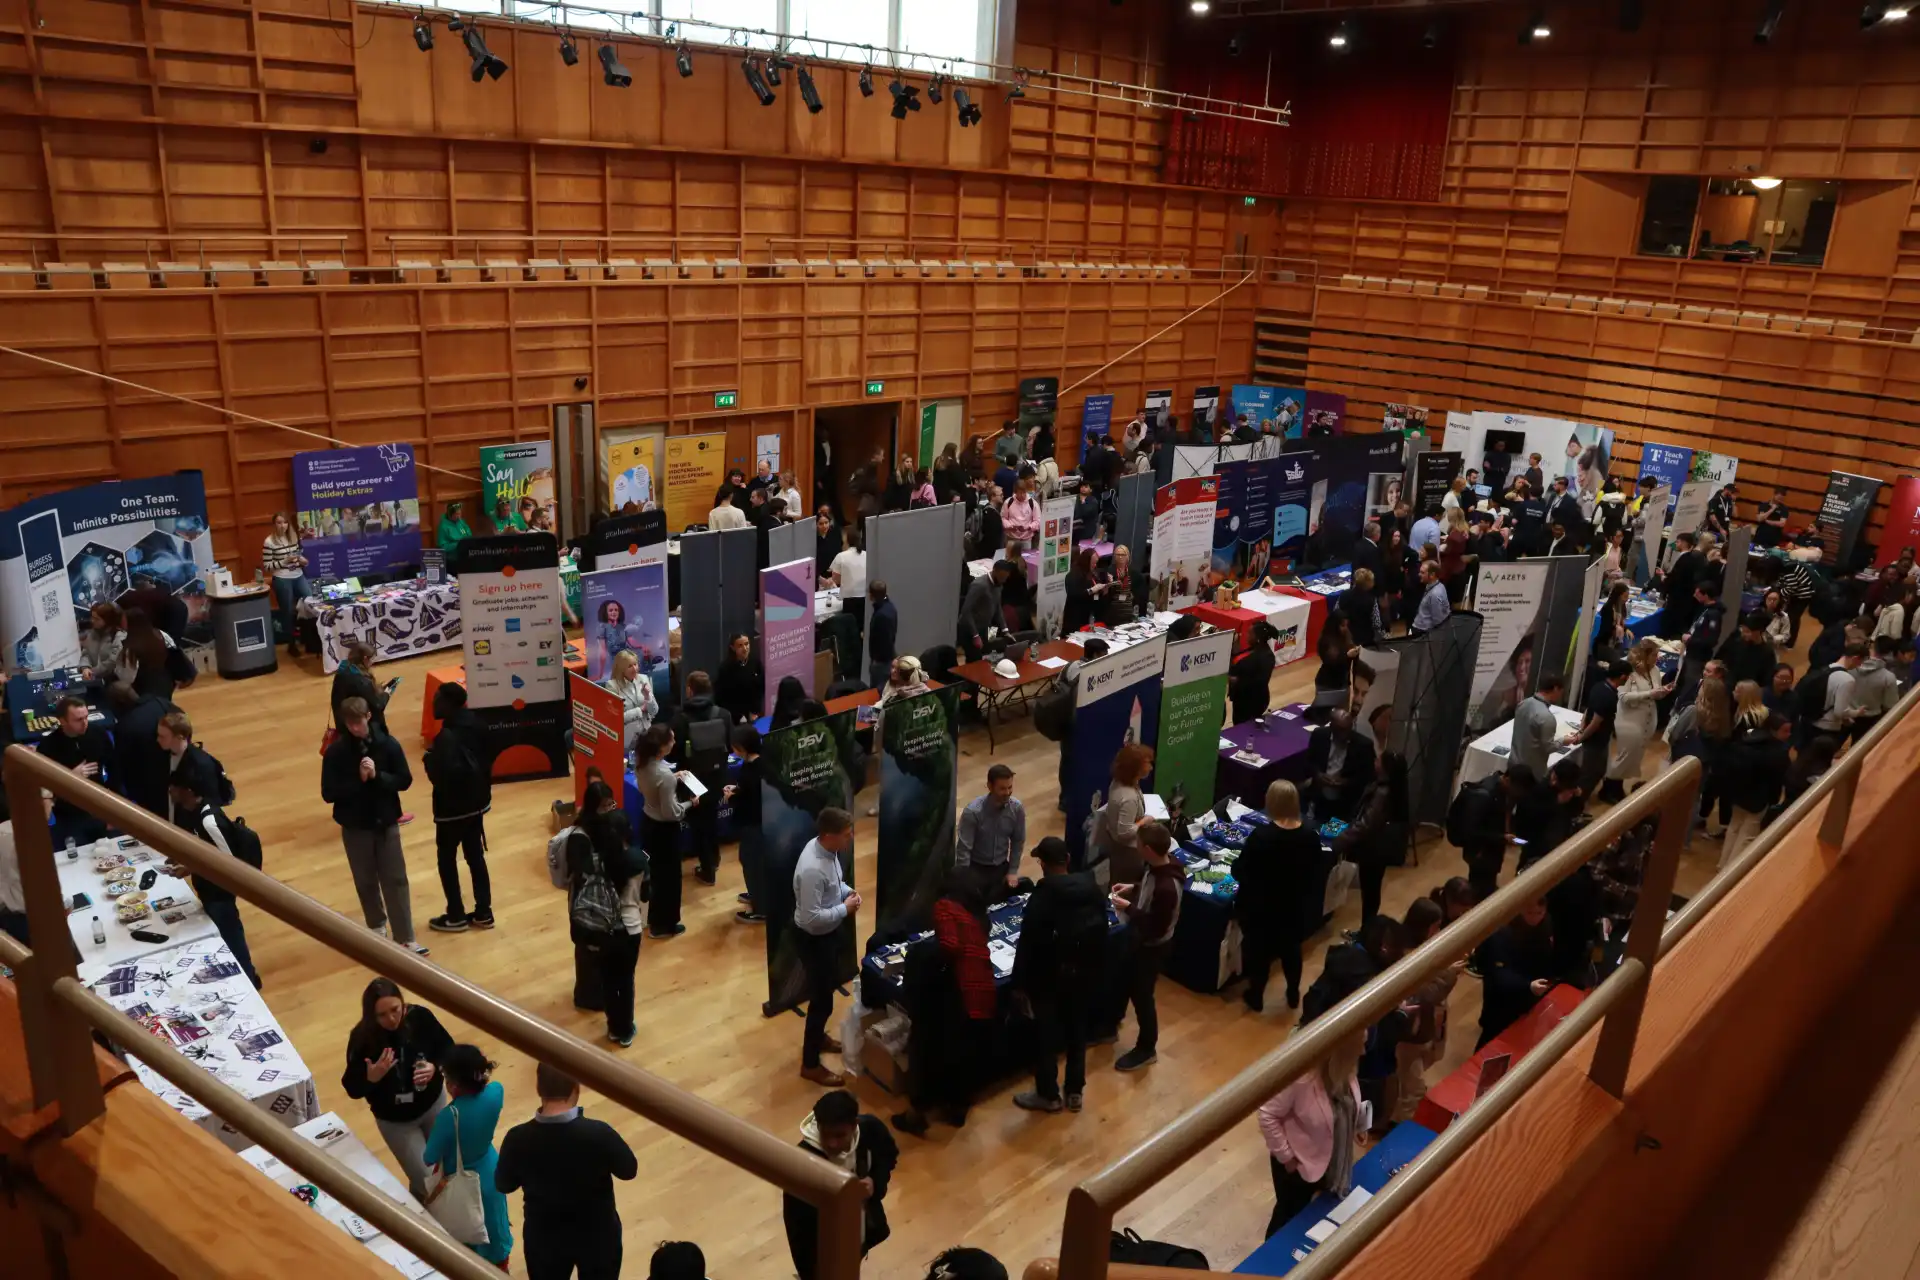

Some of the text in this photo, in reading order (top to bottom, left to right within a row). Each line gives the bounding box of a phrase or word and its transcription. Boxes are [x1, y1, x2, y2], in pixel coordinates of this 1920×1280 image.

[1663, 456, 1680, 466] First
[1664, 450, 1684, 460] Teach
[310, 481, 334, 491] Build
[335, 480, 355, 489] your
[356, 476, 382, 486] career
[486, 463, 514, 487] Say
[312, 486, 374, 500] Holiday Extras
[495, 479, 533, 500] Hello
[121, 494, 179, 508] One Team.
[73, 506, 181, 532] Infinite Possibilities.
[28, 553, 53, 572] BURGESS
[30, 562, 54, 581] HODGSON
[1501, 573, 1526, 581] AZETS
[478, 581, 543, 595] Sign up here
[472, 598, 504, 606] Graduate
[521, 594, 549, 602] schemes
[500, 603, 537, 612] internships
[472, 624, 495, 633] KPMG
[539, 640, 553, 650] EY
[1193, 651, 1217, 666] KENT
[1096, 669, 1115, 687] KENT
[1171, 690, 1211, 708] Building on
[912, 703, 937, 720] DSV
[1169, 702, 1212, 721] our Success
[1168, 716, 1204, 733] for Future
[797, 731, 825, 750] DSV
[903, 728, 944, 748] Keeping supply
[904, 738, 943, 755] chains flowing
[1167, 730, 1194, 746] Growth
[789, 759, 835, 778] Keeping supply
[791, 769, 834, 787] chains flowing
[352, 1219, 366, 1235] TEACH
